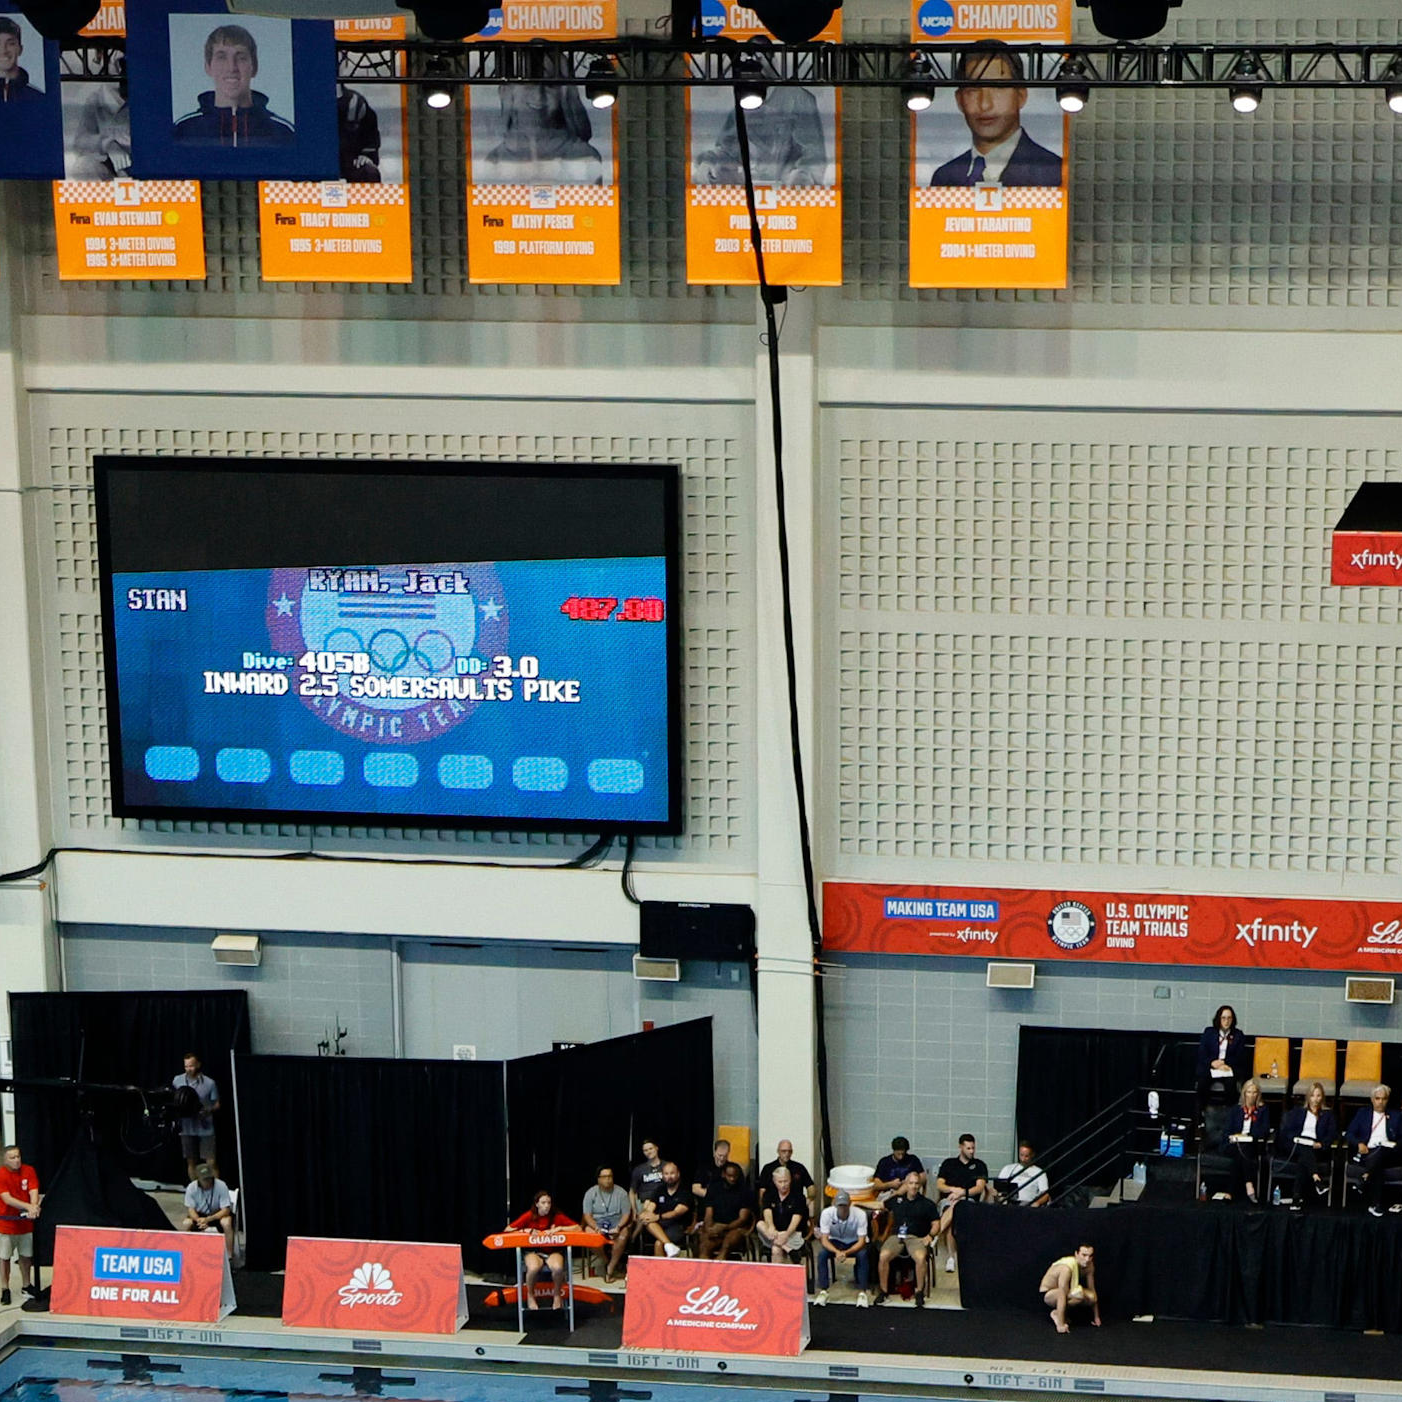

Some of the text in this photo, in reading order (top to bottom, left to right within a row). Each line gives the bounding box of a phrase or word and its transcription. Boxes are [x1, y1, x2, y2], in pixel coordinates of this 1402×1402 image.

[507, 5, 603, 30] CHAMPIONS
[921, 4, 1057, 30] NCAA CHAMPIONS
[93, 211, 163, 226] EVAN STEWART
[300, 213, 330, 227] TRACY
[512, 215, 575, 229] KATHY PESEK
[766, 215, 797, 230] JONES
[109, 237, 175, 251] 3-METER DIVING
[314, 239, 382, 253] 3-METER DIVING
[518, 241, 595, 255] PLATFORM DIVING
[781, 239, 813, 253] DIVING
[966, 244, 1003, 258] 1-METER
[1004, 244, 1036, 258] DIVING
[110, 253, 176, 267] 3-METER DIVING
[404, 571, 469, 593] Jack
[127, 589, 188, 612] STAN
[241, 651, 371, 676] Dive: 405B
[454, 655, 539, 679] DD: 3.0
[203, 671, 582, 703] INWARD 2.5 SOMERSAULTS PIKE
[887, 900, 995, 919] MAKING TEAM USA
[1105, 902, 1189, 921] U.S. OLYMPIC
[956, 927, 999, 944] xfinity
[1105, 920, 1189, 938] TEAM TRIALS
[1235, 918, 1319, 948] xfinity
[1106, 937, 1136, 949] DIVING
[528, 1233, 567, 1245] GUARD
[101, 1254, 174, 1276] TEAM USA
[90, 1286, 180, 1304] ONE FOR ALL
[338, 1285, 403, 1309] Sports
[678, 1285, 750, 1323] Lilly
[674, 1319, 715, 1328] MEDICINE
[715, 1322, 758, 1331] COMPANY
[153, 1328, 185, 1341] 15FT
[628, 1354, 660, 1367] 16FT
